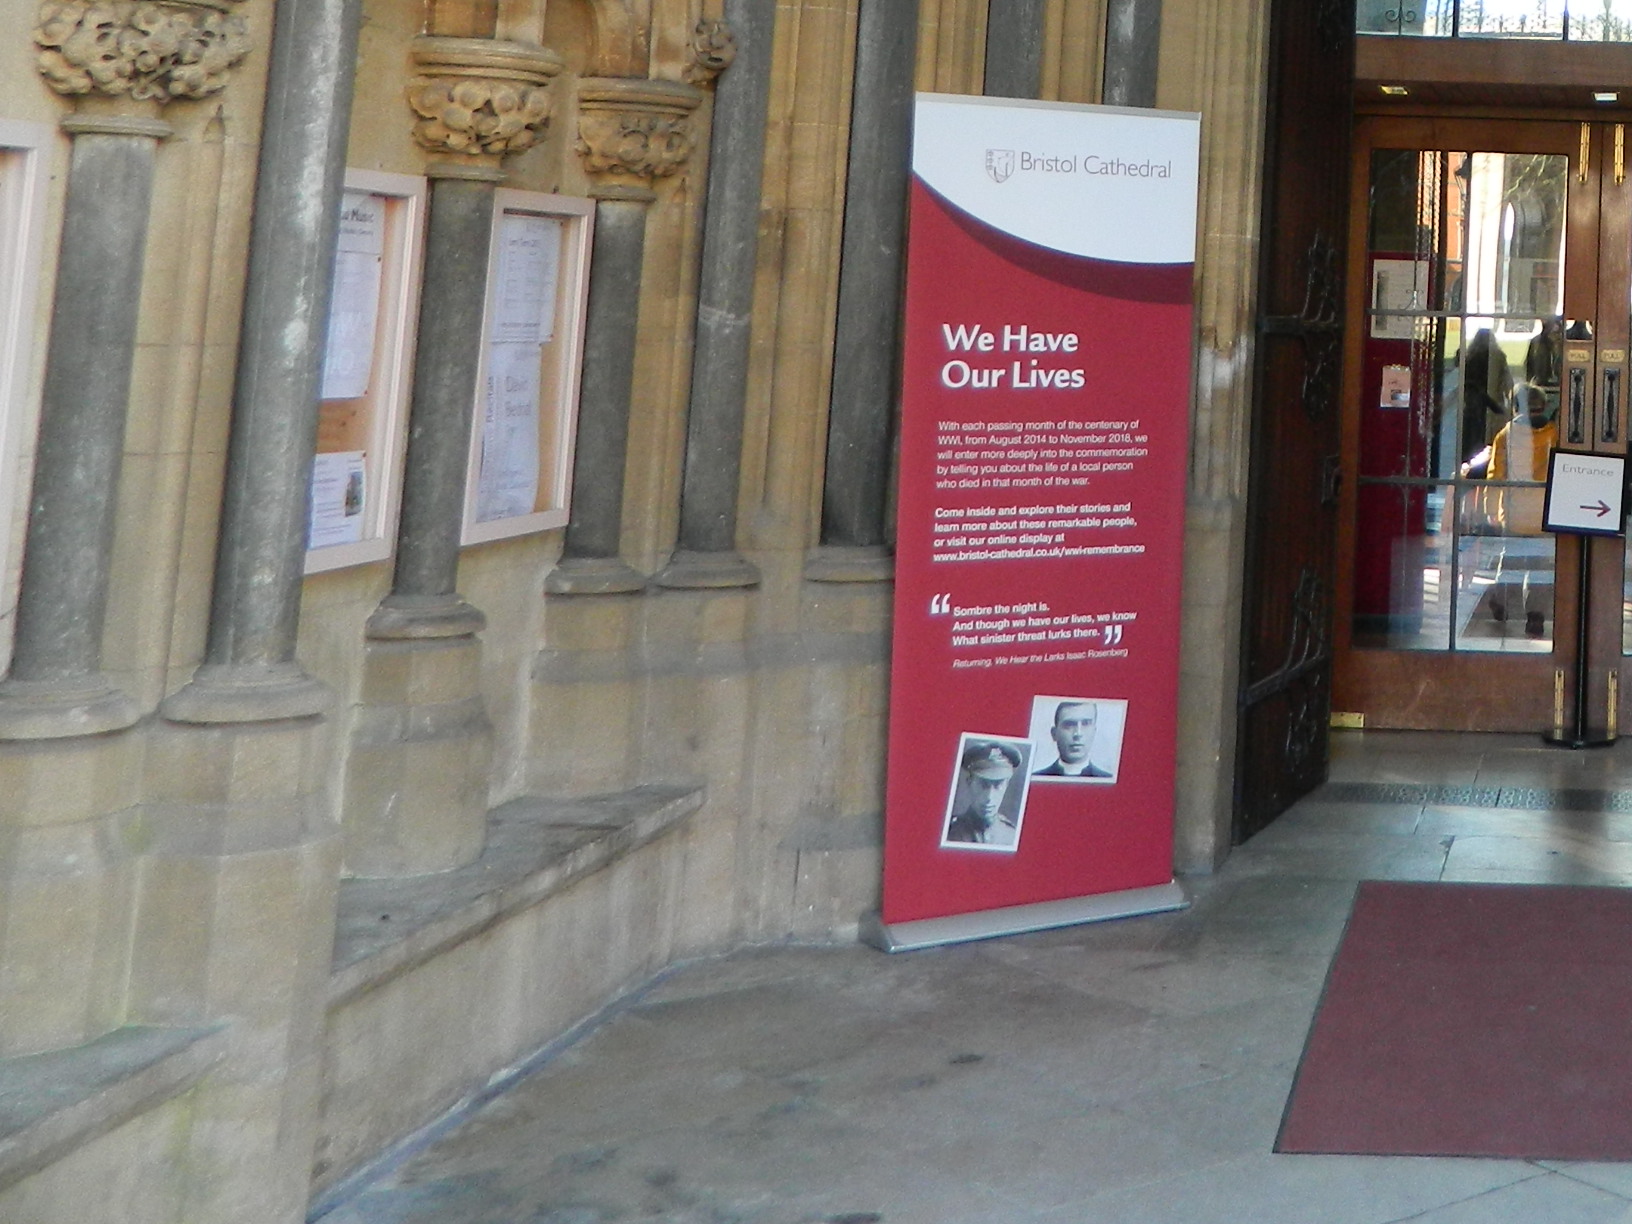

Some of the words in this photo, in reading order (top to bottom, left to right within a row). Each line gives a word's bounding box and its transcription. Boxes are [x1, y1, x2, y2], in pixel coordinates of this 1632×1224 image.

[1020, 151, 1077, 173] Bristol
[1083, 155, 1172, 178] Cathedral
[942, 322, 994, 352] We
[1003, 324, 1079, 352] Have
[941, 359, 1005, 388] Our
[1012, 359, 1085, 388] Lives
[938, 421, 960, 431] With
[962, 421, 985, 431] each
[987, 421, 1023, 432] passing
[1025, 420, 1055, 431] month
[1057, 420, 1067, 429] of
[1068, 420, 1082, 429] the
[1085, 420, 1128, 431] centenary
[1130, 419, 1139, 429] of
[938, 436, 963, 445] WWI,
[965, 435, 987, 445] from
[989, 435, 1022, 446] August
[1023, 435, 1046, 444] 2014
[1049, 435, 1058, 444] to
[1060, 434, 1106, 443] November
[1108, 433, 1133, 444] 2018,
[1134, 434, 1148, 443] we
[937, 450, 952, 459] will
[954, 450, 979, 459] enter
[981, 450, 1005, 459] more
[1007, 449, 1038, 460] deeply
[1040, 449, 1057, 458] into
[1059, 448, 1073, 458] the
[1075, 447, 1148, 457] commemoration
[937, 465, 949, 476] by
[950, 464, 979, 475] telling
[980, 465, 998, 475] you
[999, 463, 1026, 473] about
[1028, 463, 1043, 472] the
[1045, 462, 1058, 472] life
[1060, 462, 1070, 471] of
[1071, 463, 1078, 471] a
[1079, 462, 1100, 471] local
[1102, 462, 1133, 472] person
[1562, 463, 1614, 477] Entrance
[936, 478, 957, 488] who
[959, 478, 980, 488] died
[982, 478, 991, 487] in
[992, 477, 1010, 487] that
[1012, 477, 1042, 486] month
[1044, 476, 1054, 486] of
[1055, 476, 1070, 486] the
[1071, 477, 1090, 485] war.
[935, 507, 964, 518] Come
[998, 505, 1017, 516] and
[1019, 504, 1054, 516] explore
[1056, 504, 1078, 513] their
[1080, 503, 1111, 513] stories
[1113, 502, 1131, 512] and
[934, 522, 959, 532] learn
[961, 522, 987, 531] more
[989, 520, 1017, 530] about
[1019, 519, 1046, 529] these
[1048, 517, 1101, 528] remarkable
[1102, 516, 1137, 528] people,
[934, 538, 945, 547] or
[947, 536, 966, 546] visit
[968, 537, 985, 545] our
[987, 534, 1017, 544] online
[1019, 533, 1053, 545] display
[1055, 533, 1065, 542] at
[953, 606, 992, 617] Sombre
[994, 604, 1010, 614] the
[1012, 602, 1037, 615] night
[952, 621, 974, 631] And
[975, 619, 1010, 630] though
[1011, 619, 1026, 627] we
[1028, 616, 1051, 626] have
[1053, 616, 1070, 625] our
[1071, 614, 1095, 624] lives,
[1097, 613, 1110, 622] we
[1112, 611, 1137, 621] know
[952, 635, 978, 646] What
[980, 633, 1015, 644] sinister
[1017, 631, 1046, 642] threat
[1048, 629, 1071, 639] lurks
[1073, 628, 1100, 638] there.
[995, 656, 1008, 665] We
[1009, 655, 1029, 664] Hear
[1029, 654, 1042, 663] the
[1043, 652, 1065, 662] Larks
[1066, 651, 1086, 660] Isaac
[1087, 648, 1128, 658] Rosenberg
